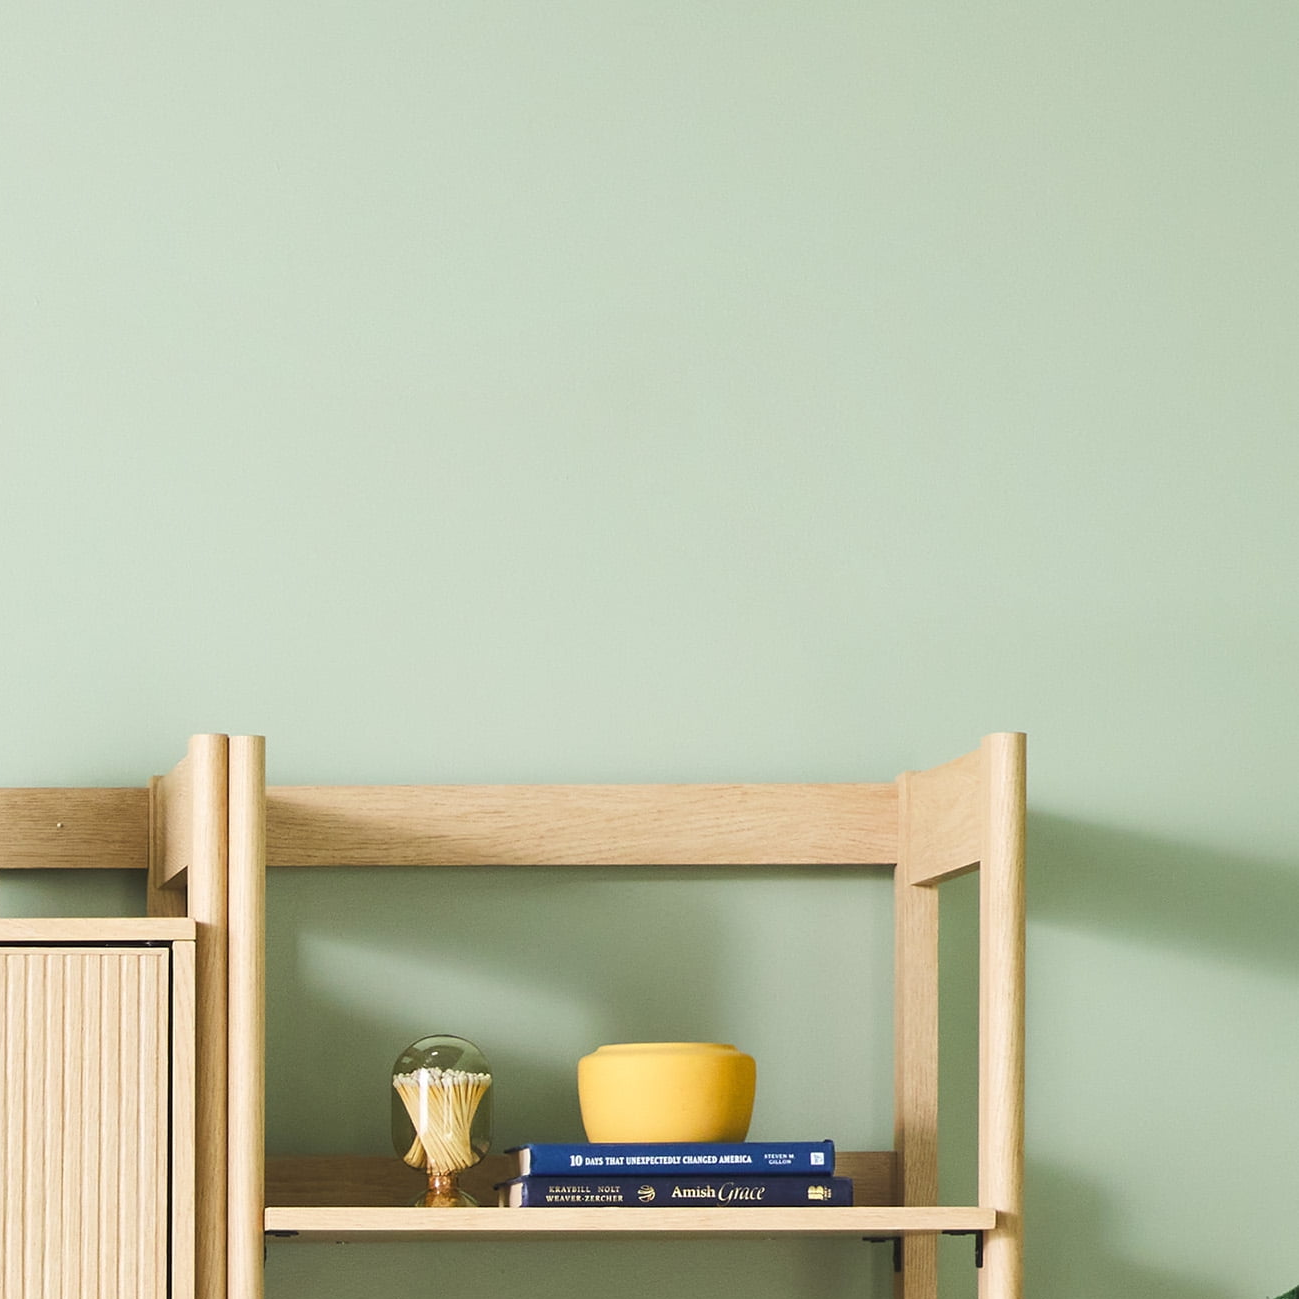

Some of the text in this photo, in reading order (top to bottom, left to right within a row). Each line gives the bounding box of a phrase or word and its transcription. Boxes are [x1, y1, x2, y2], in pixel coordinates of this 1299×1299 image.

[569, 1154, 752, 1167] 10 DAYS THAT UNEXPECTEDLY CHANGED AMERICA
[671, 1182, 765, 1207] Amish Grace
